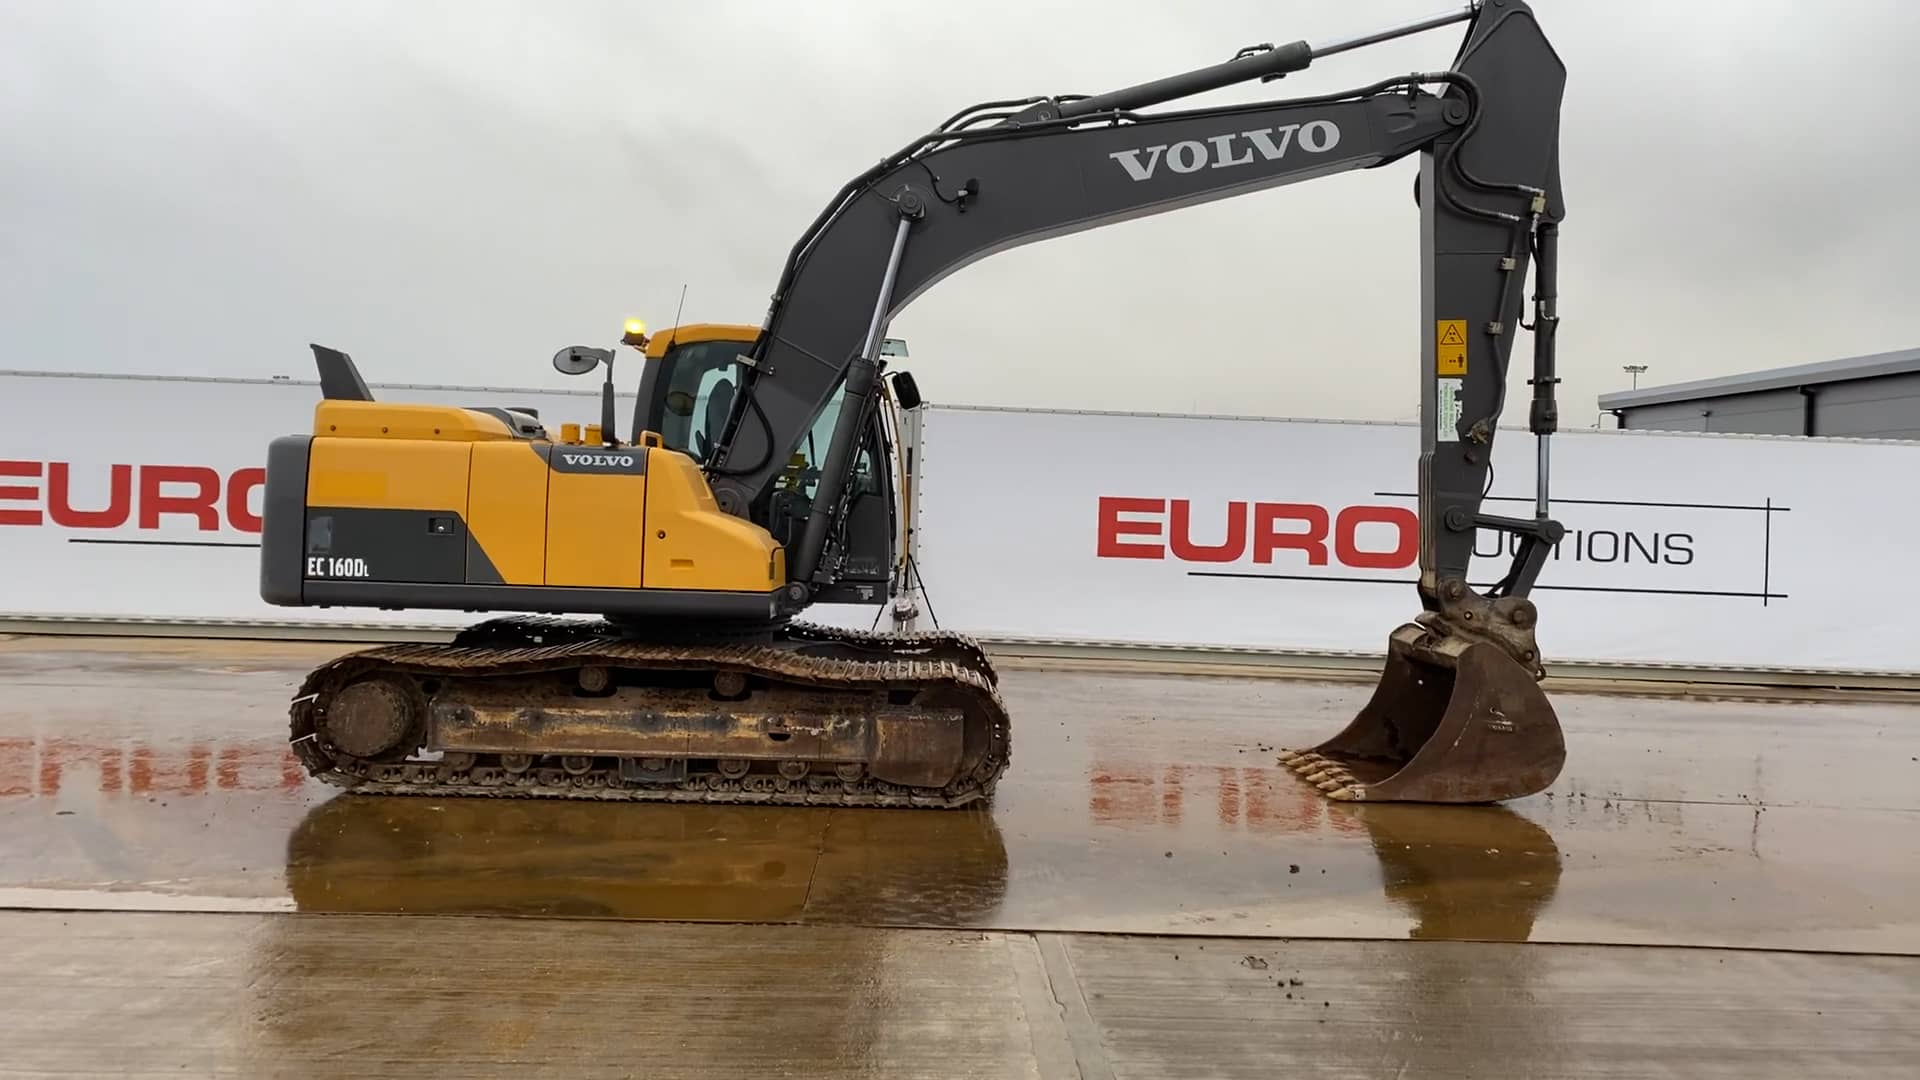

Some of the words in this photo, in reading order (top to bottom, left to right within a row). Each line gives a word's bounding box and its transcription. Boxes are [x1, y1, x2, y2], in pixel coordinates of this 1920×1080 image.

[1109, 120, 1341, 181] VOLVO
[562, 454, 634, 467] VOLVO
[1097, 496, 1419, 569] EURO
[307, 557, 325, 576] EC
